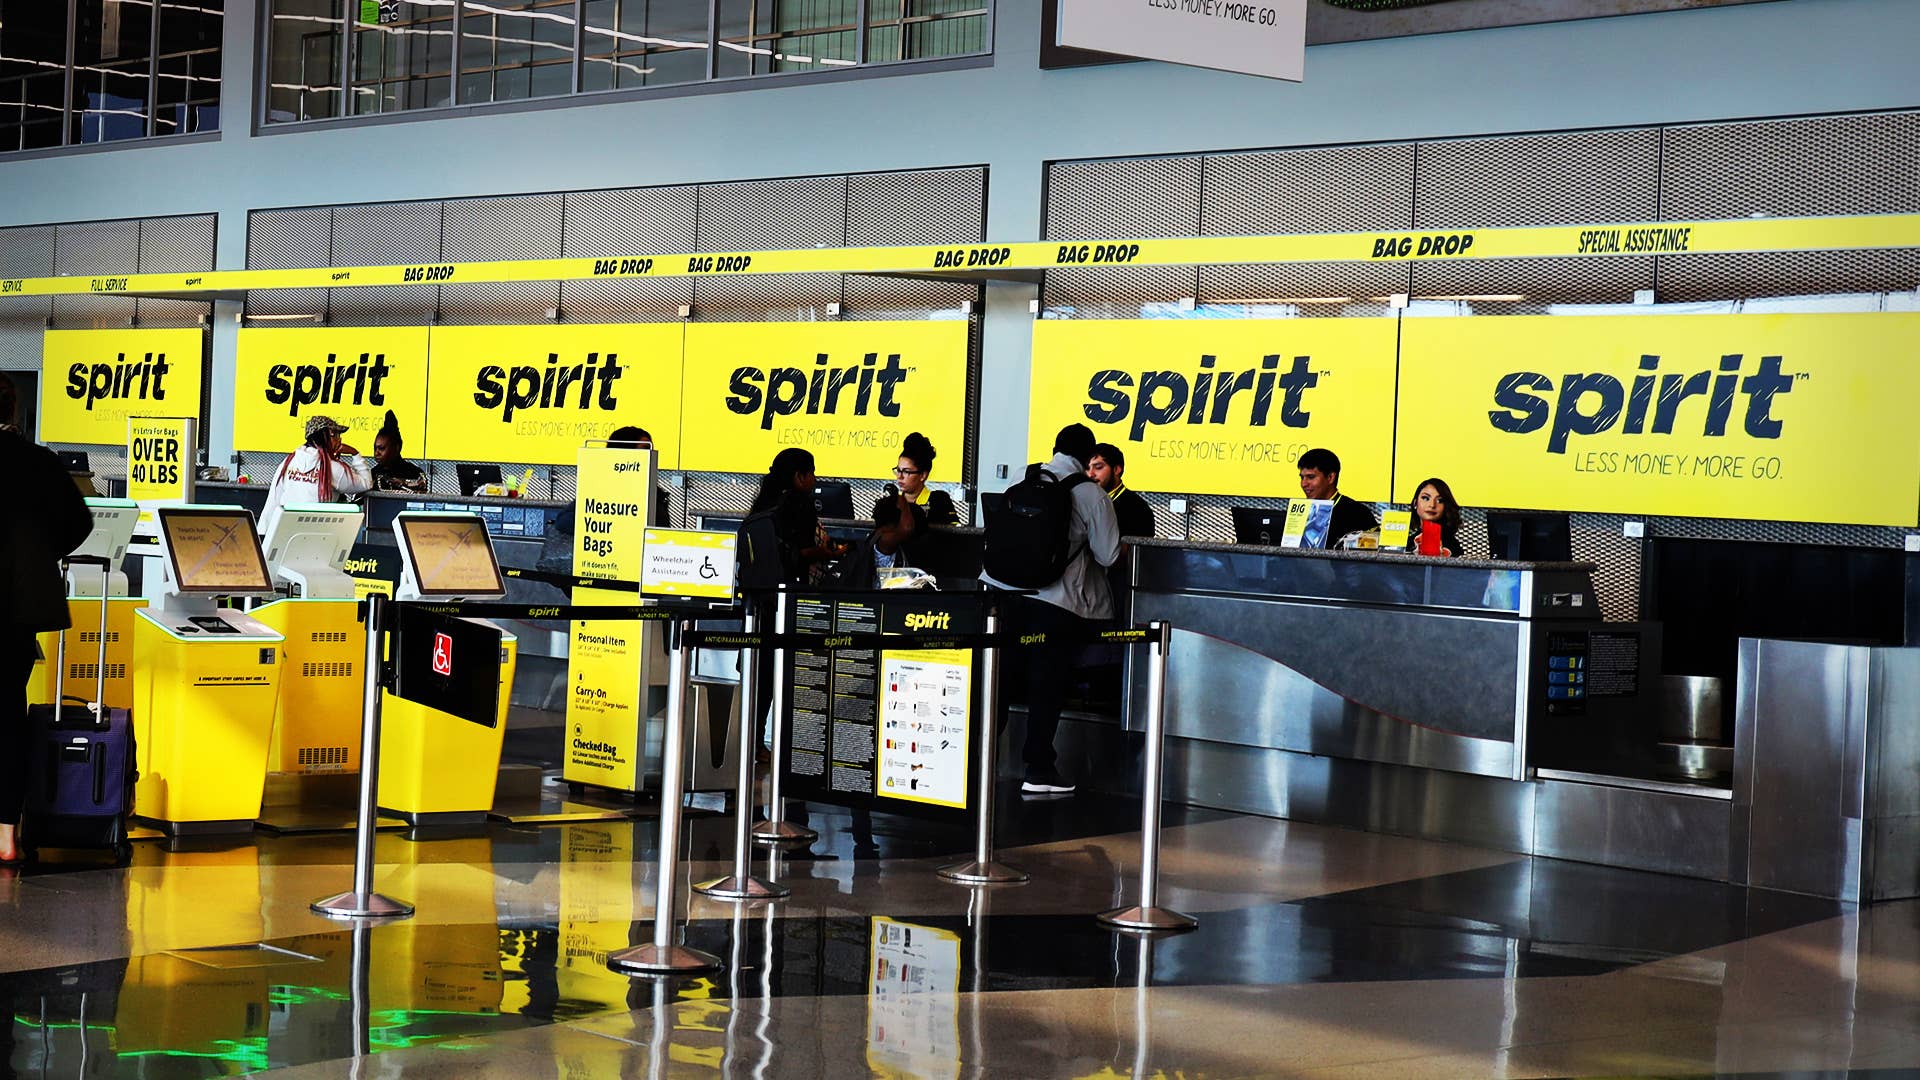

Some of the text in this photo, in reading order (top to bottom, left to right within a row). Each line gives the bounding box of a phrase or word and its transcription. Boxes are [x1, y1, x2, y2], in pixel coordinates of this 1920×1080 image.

[1224, 2, 1256, 23] MORE
[1258, 7, 1278, 26] GO.
[1371, 234, 1474, 258] BAG DROP
[1578, 227, 1691, 253] SPECIAL ASSISTANCE
[933, 247, 1011, 268] BAG DROP
[1056, 244, 1140, 263] BAG DROP
[593, 258, 653, 276] BAG DROP
[687, 255, 752, 273] BAG DROP
[185, 278, 202, 286] spirit
[331, 271, 351, 281] spirit
[404, 265, 455, 282] BAG DROP
[2, 280, 23, 292] SERVICE
[91, 278, 128, 292] FULL SERVICE
[66, 353, 169, 411] spirit
[265, 353, 390, 417] spirit
[473, 352, 622, 423] spirit
[725, 352, 907, 431] spirit
[1083, 354, 1319, 442] spirit
[1488, 354, 1794, 454] spirit
[164, 428, 178, 437] Bags
[516, 421, 538, 436] LESS
[573, 422, 599, 438] MORE
[777, 428, 804, 445] LESS
[848, 430, 878, 447] MORE
[133, 437, 179, 463] OVER
[1150, 440, 1184, 458] LESS
[1241, 443, 1281, 463] MORE
[132, 464, 178, 485] 40 LBS
[614, 461, 641, 473] spirit
[1575, 452, 1784, 480] LESS MONEY. MORE GO.
[585, 498, 638, 517] Measure
[1291, 503, 1306, 513] BIG
[584, 517, 613, 534] Your
[583, 536, 613, 557] Bags
[344, 557, 378, 574] spirit
[652, 555, 694, 565] Wheelchair
[651, 567, 689, 576] Assistance
[529, 607, 560, 618] spirit
[904, 611, 951, 630] spirit
[579, 632, 626, 647] Personal Item
[824, 635, 853, 648] spirit
[1020, 632, 1046, 646] spirit
[576, 685, 607, 699] Carry-On
[573, 738, 617, 757] Checked Bag
